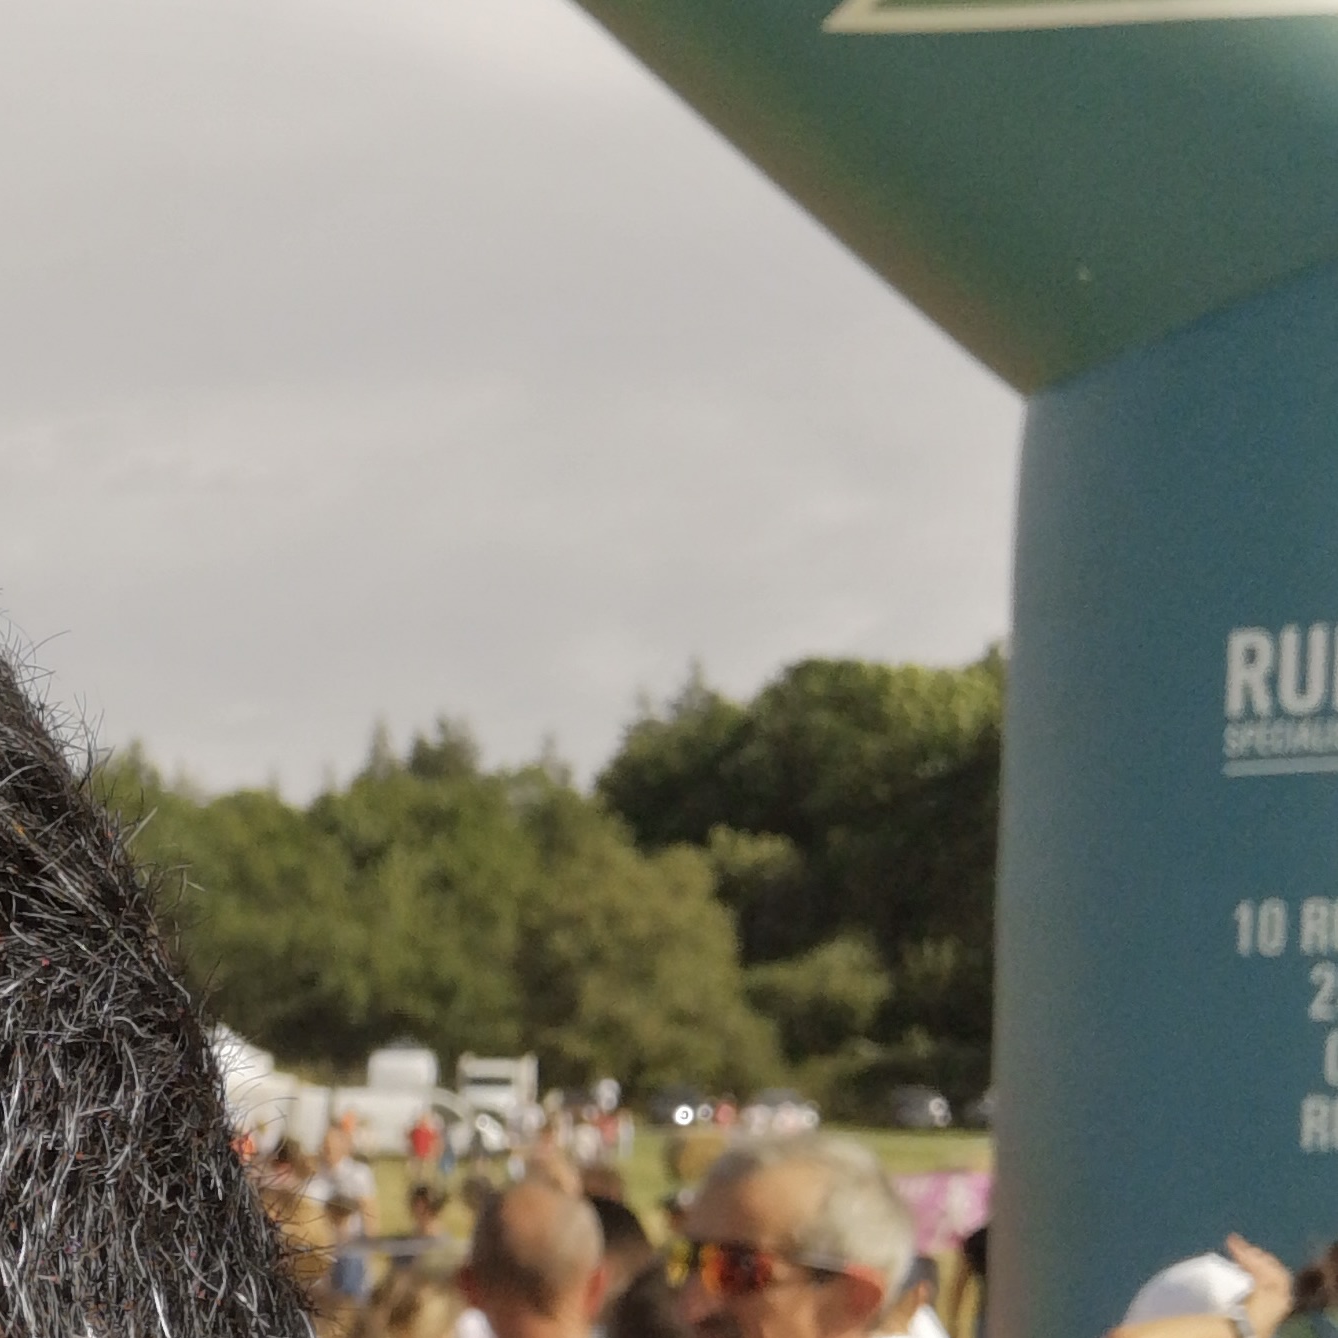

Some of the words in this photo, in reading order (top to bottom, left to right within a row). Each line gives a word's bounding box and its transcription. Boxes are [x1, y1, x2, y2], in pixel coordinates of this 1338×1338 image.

[1224, 623, 1338, 718] RU
[1233, 897, 1288, 958] 10
[1300, 895, 1338, 957] R
[1299, 1093, 1338, 1154] R
